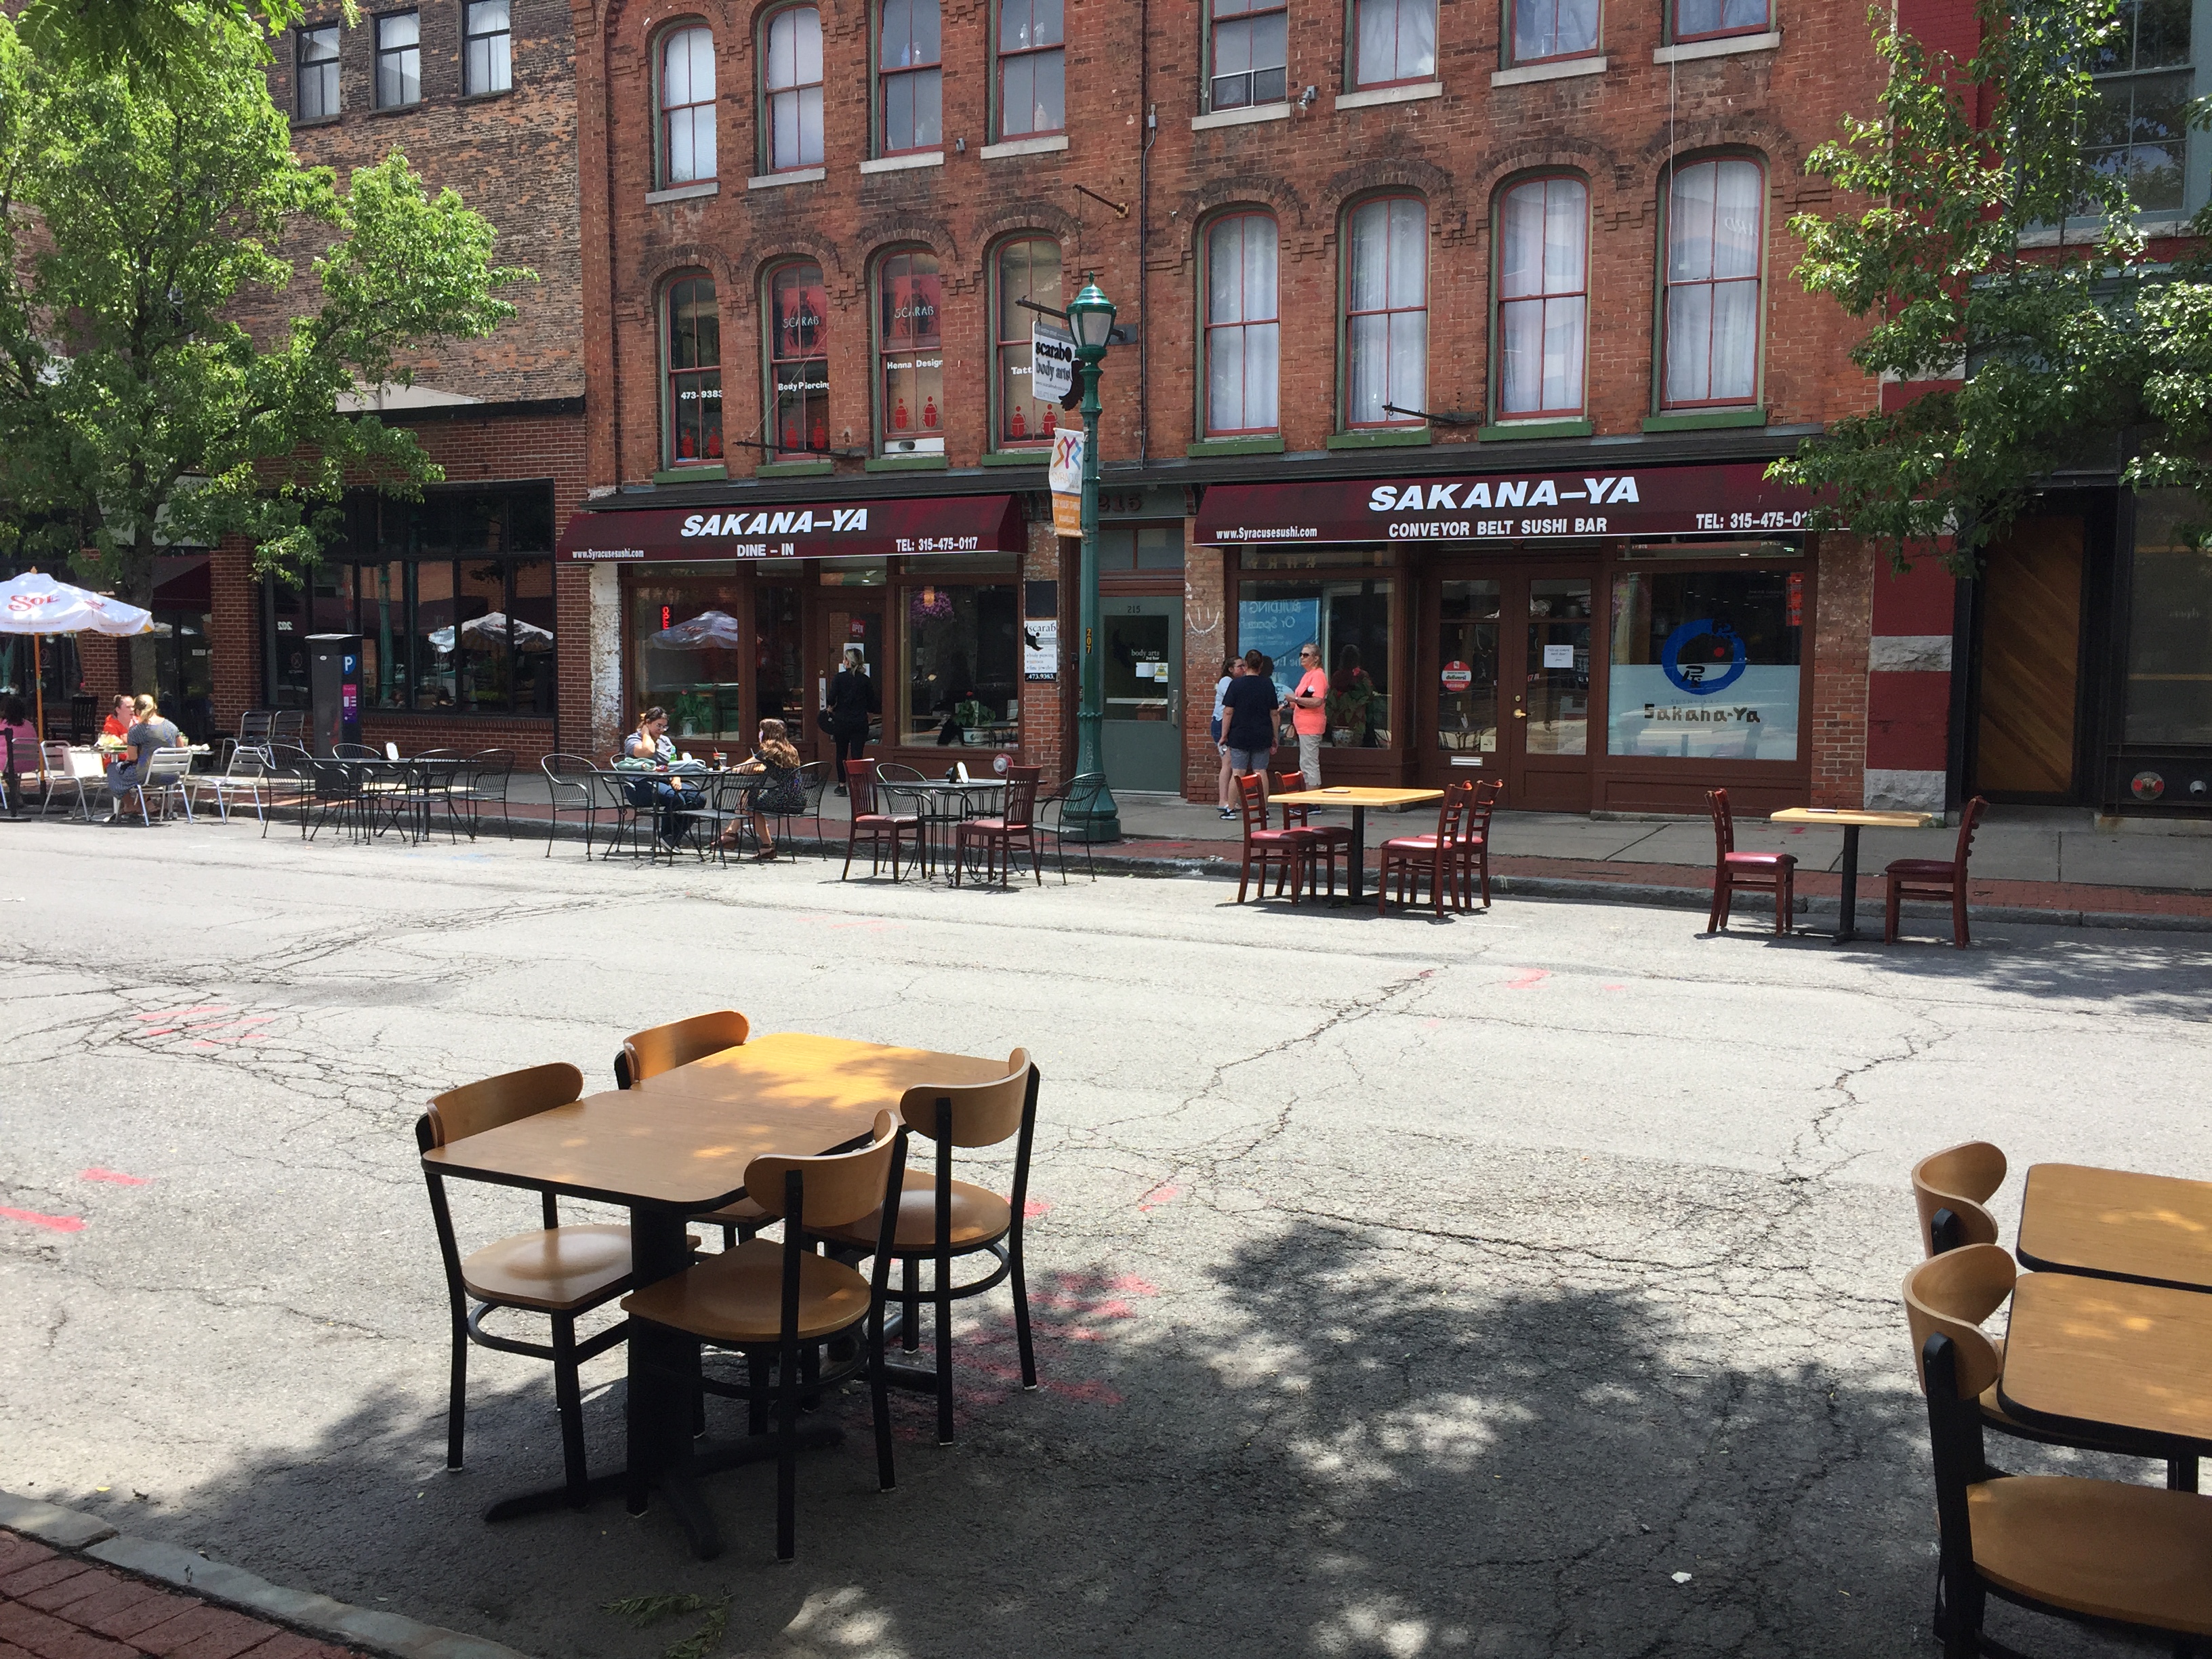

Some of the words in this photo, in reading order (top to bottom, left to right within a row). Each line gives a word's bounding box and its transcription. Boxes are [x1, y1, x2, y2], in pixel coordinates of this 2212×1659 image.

[895, 305, 935, 319] SCARAB
[783, 316, 819, 329] SCARAB
[1036, 342, 1065, 361] scarab
[887, 361, 912, 369] Henna
[1036, 357, 1054, 382] body
[778, 382, 798, 392] Body
[1368, 476, 1639, 512] SAKANA-YA
[1099, 493, 1141, 512] 215
[680, 509, 867, 537] SAKANA-YA
[1389, 521, 1469, 537] CONVEYOR
[1477, 520, 1513, 535] BELT
[1521, 518, 1568, 534] SUSHI
[1575, 517, 1607, 533] BAR
[1696, 514, 1724, 529] TEL:
[1216, 526, 1317, 541] www.Syracusesushi.com
[737, 544, 766, 557] DINE
[781, 543, 794, 556] IN
[896, 539, 915, 552] TEL:
[918, 537, 978, 551] 315-475-0117
[572, 548, 644, 560] www.Syracusesushi.com
[1127, 605, 1141, 613] 215
[1029, 623, 1056, 632] scarab
[1131, 649, 1146, 658] body
[344, 656, 353, 671] P
[1644, 703, 1760, 722] Sakana-Ya
